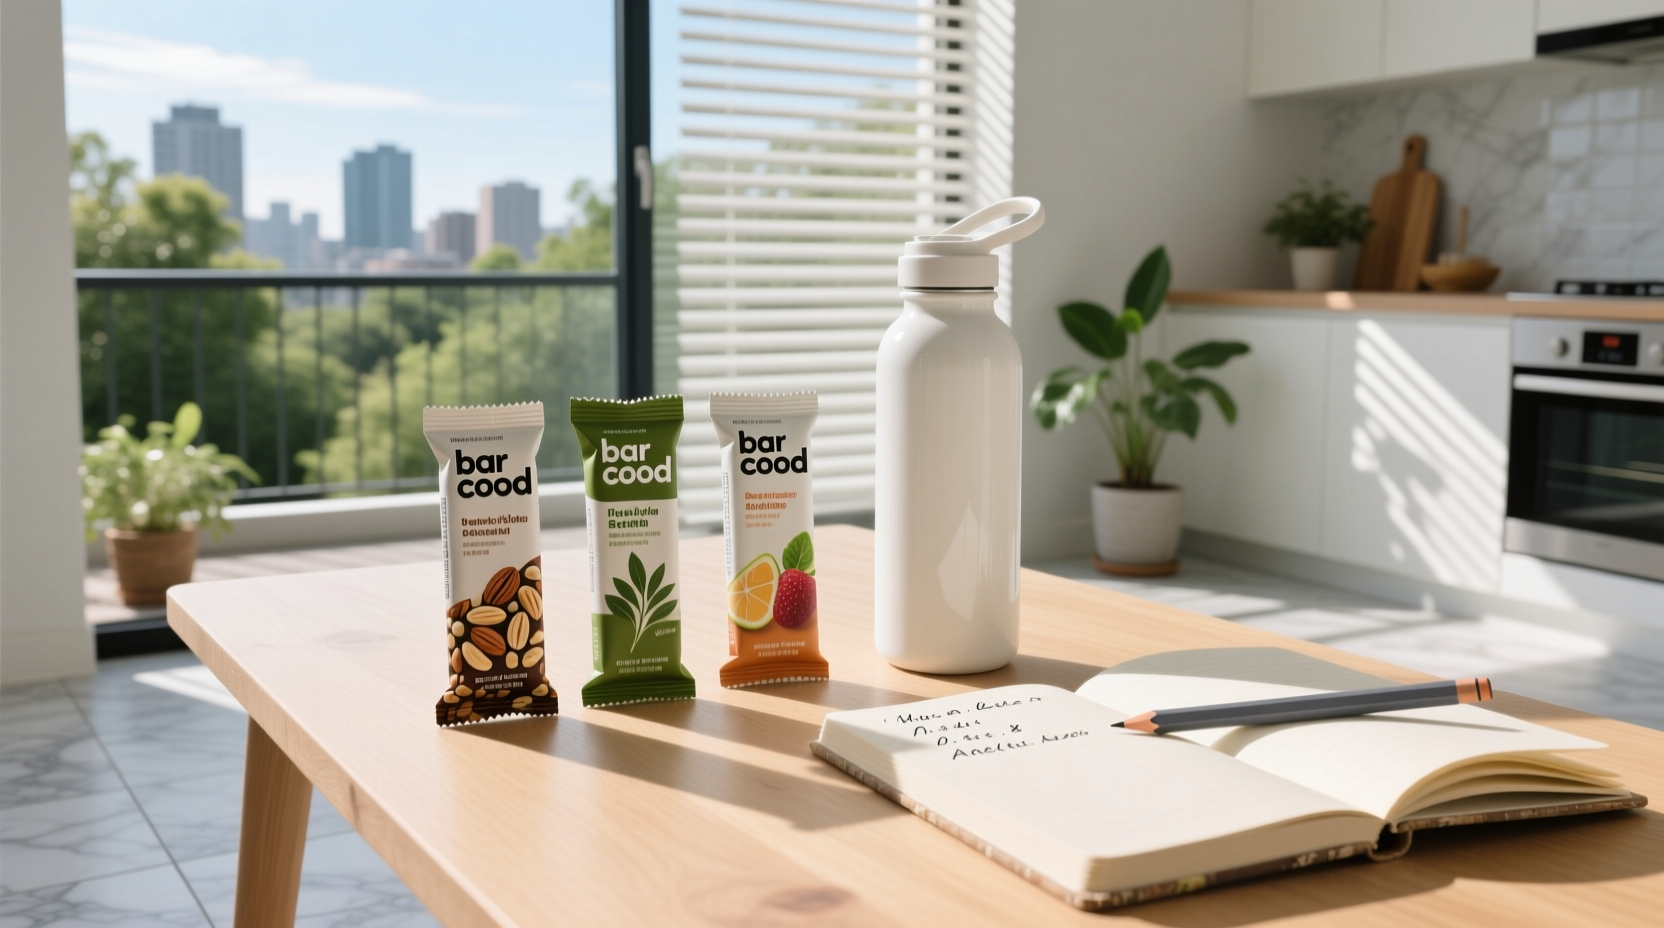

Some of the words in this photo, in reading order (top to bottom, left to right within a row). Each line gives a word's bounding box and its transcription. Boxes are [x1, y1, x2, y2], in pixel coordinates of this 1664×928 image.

[601, 438, 651, 463] bar
[738, 430, 787, 454] bar
[455, 449, 508, 475] bar
[602, 455, 672, 485] cood
[740, 447, 808, 475] cood
[457, 466, 532, 499] cood
